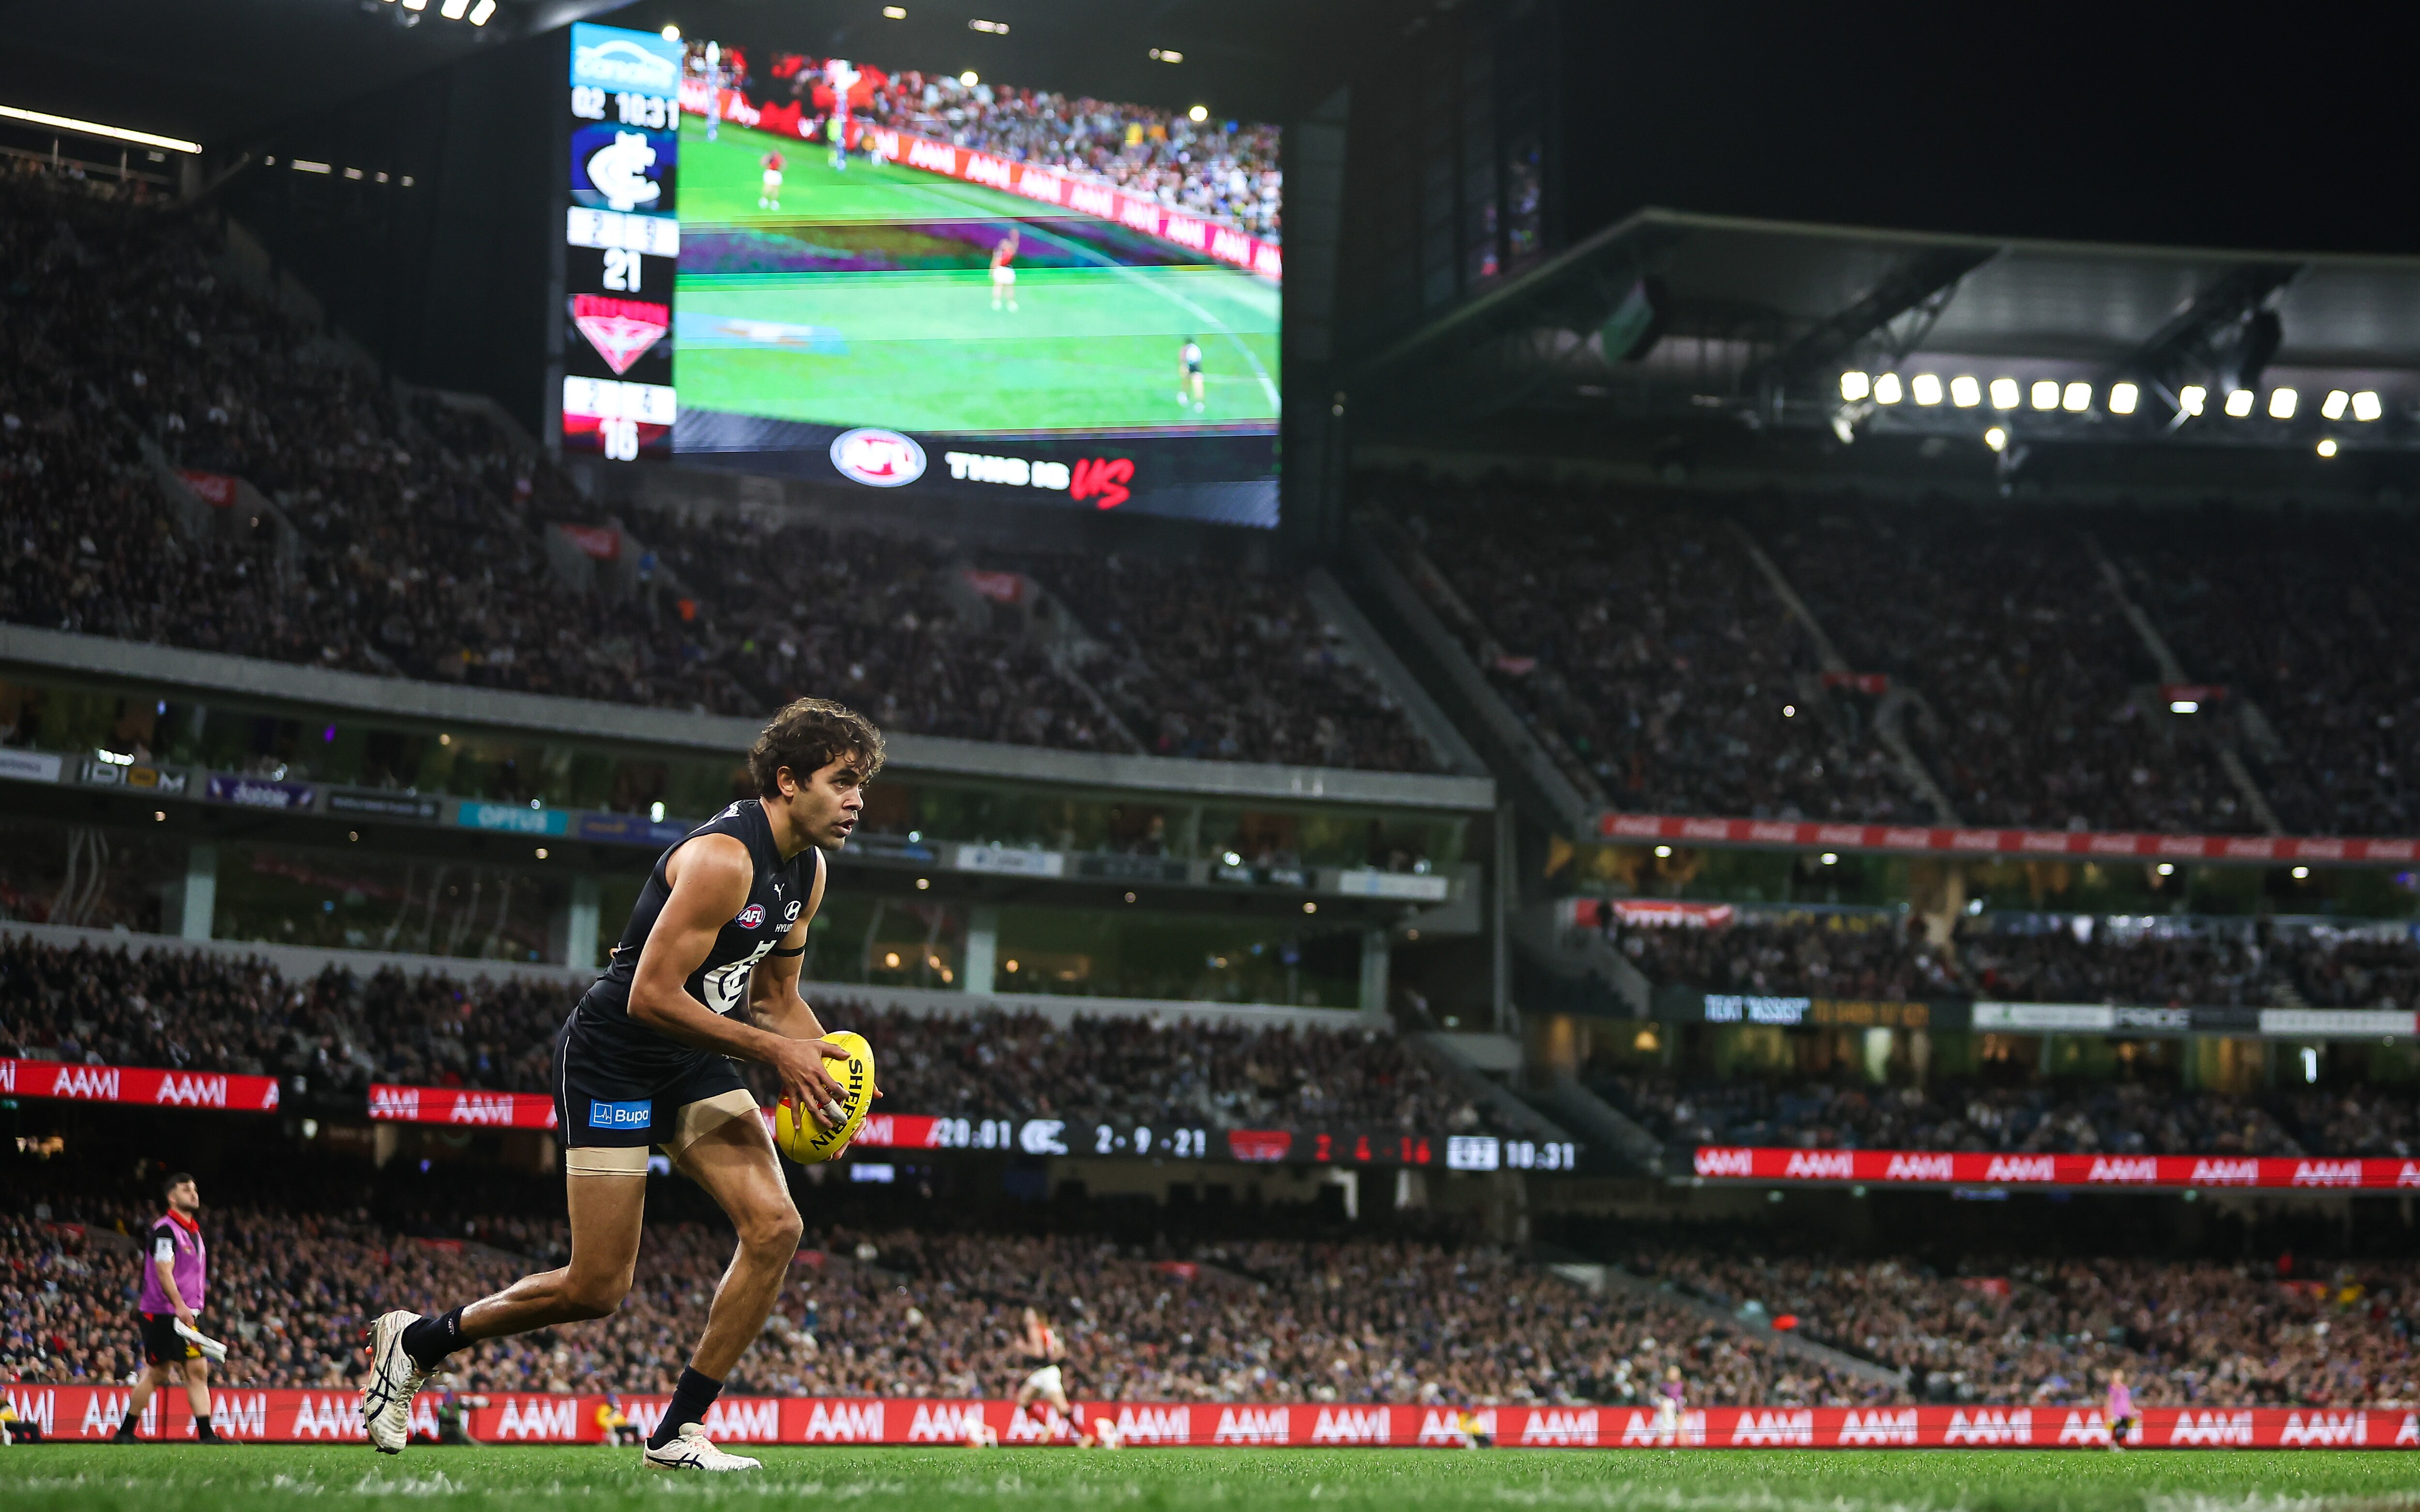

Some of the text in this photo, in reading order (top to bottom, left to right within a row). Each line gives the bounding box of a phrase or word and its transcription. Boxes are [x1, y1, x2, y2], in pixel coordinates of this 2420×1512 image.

[603, 247, 642, 293] 21
[737, 910, 762, 923] AFL
[53, 1067, 120, 1099] AAMI
[157, 1074, 227, 1107] AAMI
[450, 1093, 514, 1126] AAMI
[615, 1109, 649, 1122] Bupa
[1785, 1150, 1853, 1179] AAMI
[1886, 1153, 1953, 1180] AAMI
[1985, 1154, 2054, 1181] AAMI
[2087, 1157, 2157, 1184] AAMI
[2190, 1158, 2259, 1185] AAMI
[2292, 1159, 2362, 1187] AAMI
[496, 1398, 578, 1441] AAMI
[705, 1399, 779, 1441] AAMI
[804, 1400, 885, 1442] AAMI
[1115, 1405, 1191, 1443] AAMI
[1212, 1406, 1290, 1444] AAMI
[1311, 1406, 1391, 1444] AAMI
[1520, 1408, 1599, 1446] AAMI
[1731, 1408, 1814, 1446] AAMI
[1837, 1407, 1919, 1445] AAMI
[1943, 1407, 2032, 1444] AAMI
[2169, 1409, 2254, 1445] AAMI
[2280, 1411, 2368, 1445] AAMI
